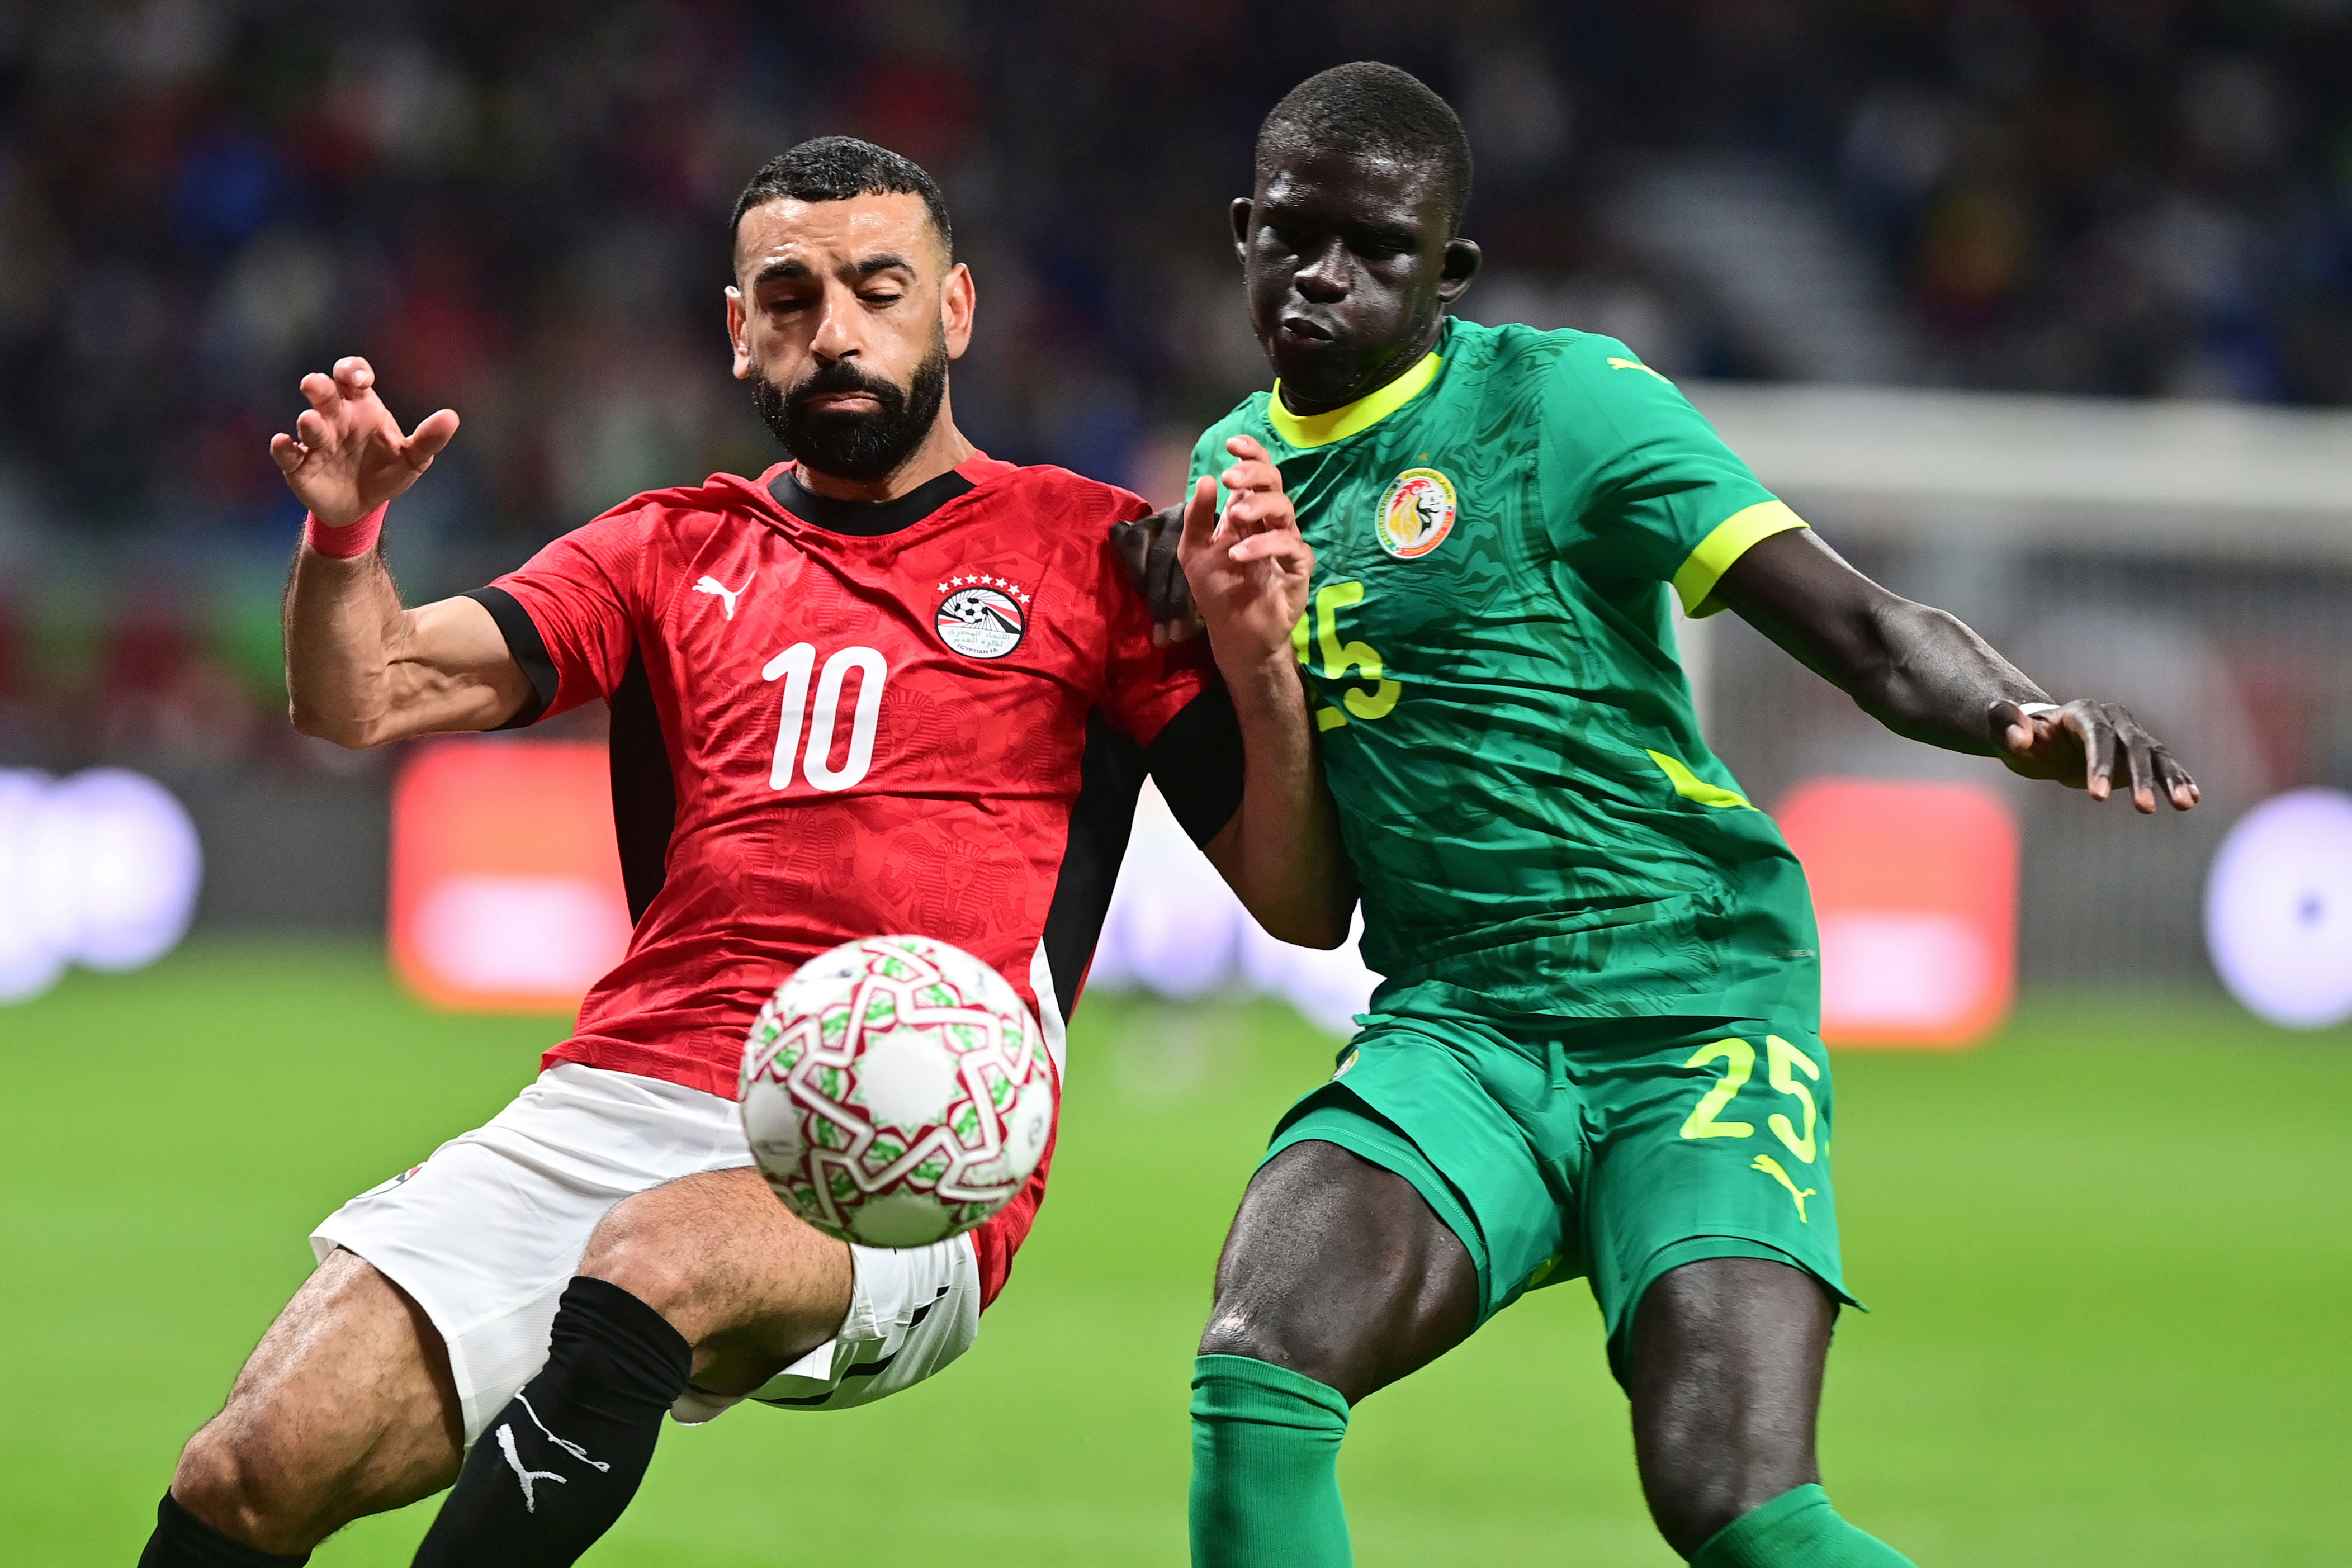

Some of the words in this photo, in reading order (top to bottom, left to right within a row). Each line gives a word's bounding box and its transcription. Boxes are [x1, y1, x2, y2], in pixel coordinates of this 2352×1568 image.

[957, 643, 988, 655] EGYPTIAN
[761, 642, 888, 792] 10
[1679, 1034, 1820, 1164] 25
